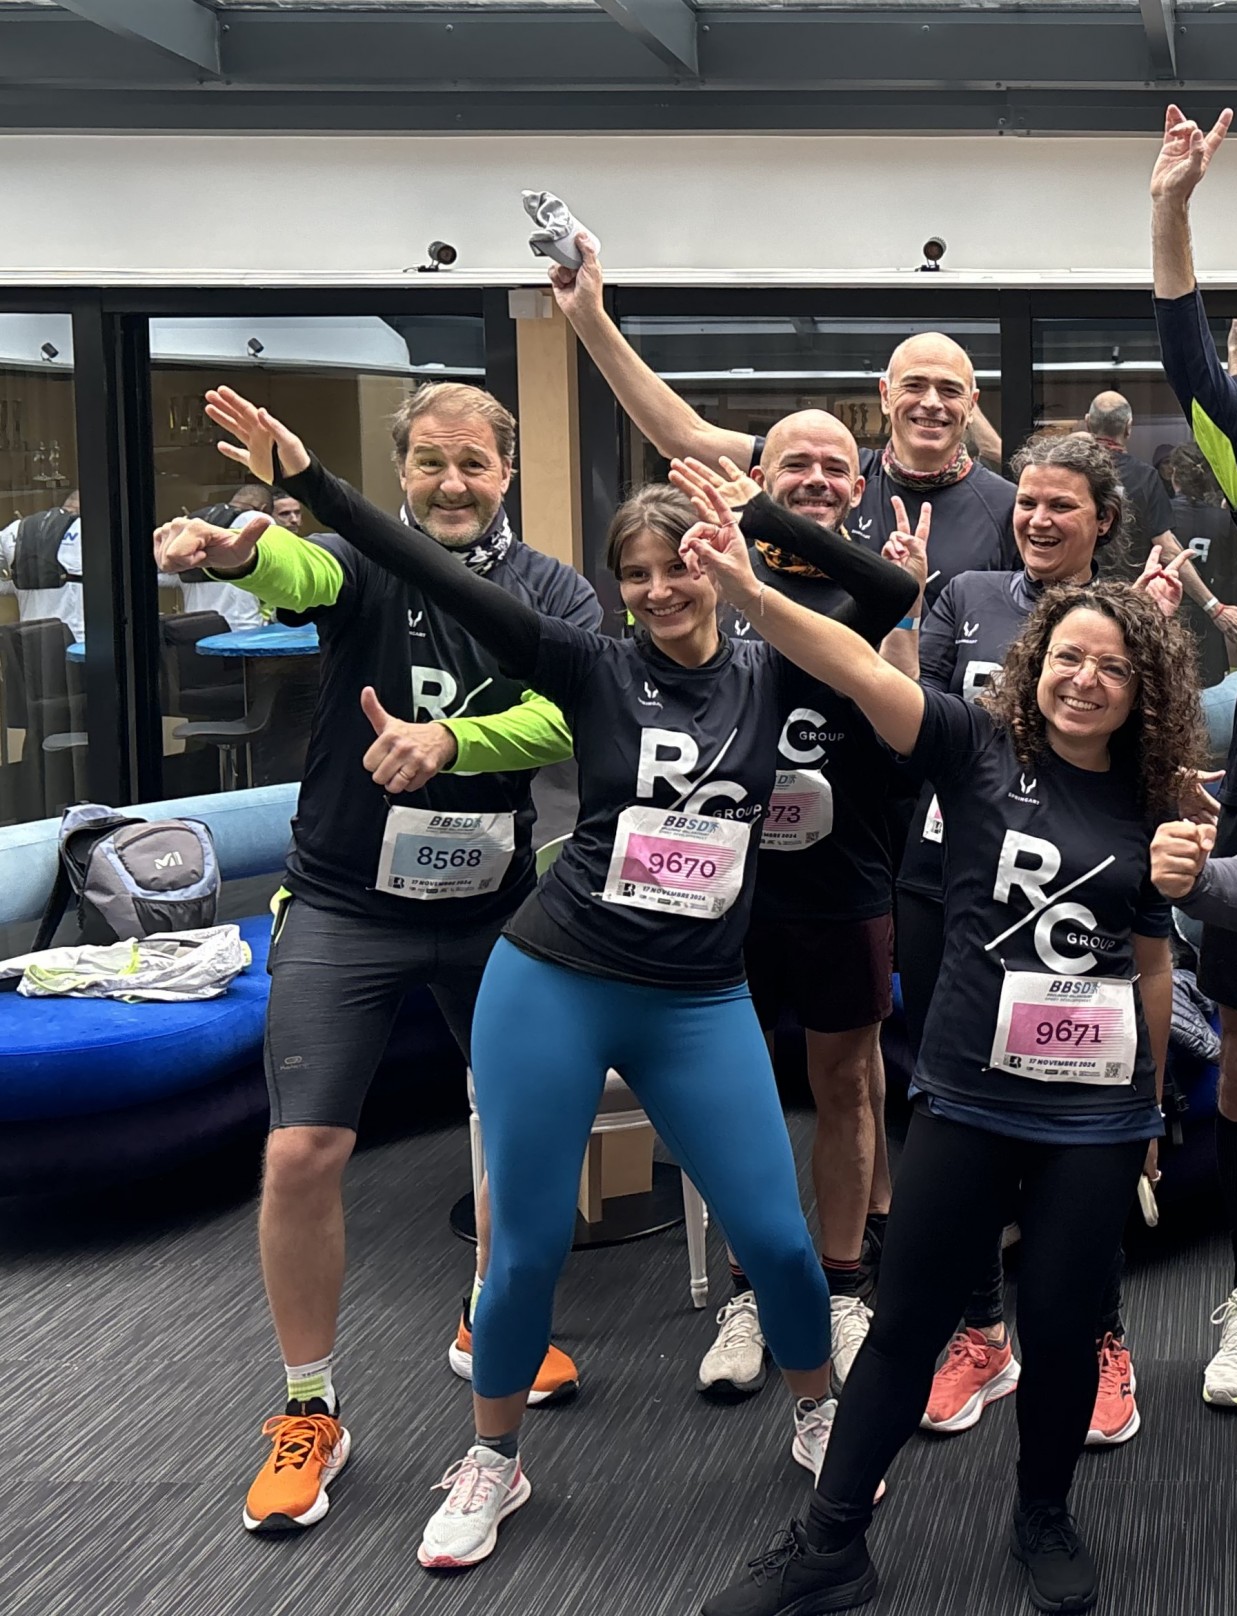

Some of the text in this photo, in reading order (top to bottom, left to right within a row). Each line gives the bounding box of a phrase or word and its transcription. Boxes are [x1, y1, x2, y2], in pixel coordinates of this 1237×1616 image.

[799, 731, 845, 742] GROUP
[429, 815, 474, 829] BBSD
[663, 815, 710, 832] BBSD
[416, 846, 482, 870] 8568
[648, 852, 717, 879] 9670
[1066, 932, 1116, 951] GROUP
[1049, 980, 1092, 994] BBSD
[1036, 1019, 1102, 1047] 9671
